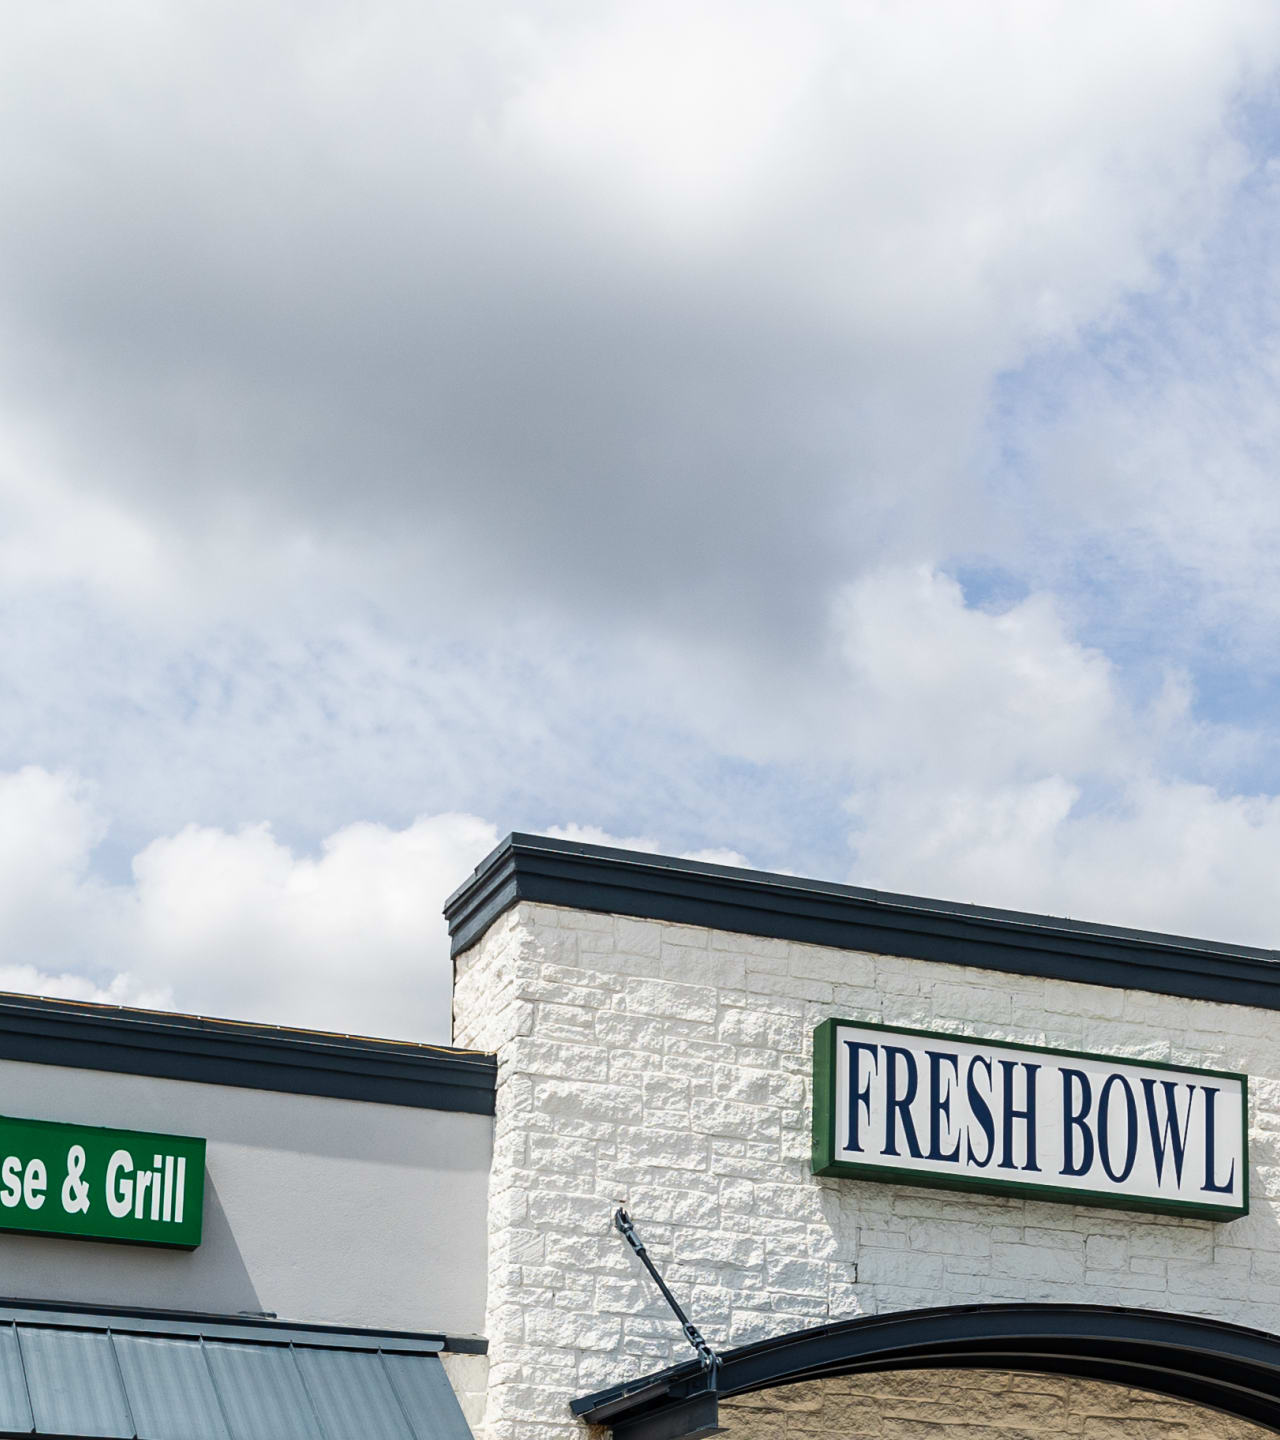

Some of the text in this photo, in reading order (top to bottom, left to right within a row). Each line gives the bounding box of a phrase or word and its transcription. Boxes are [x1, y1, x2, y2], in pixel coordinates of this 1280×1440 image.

[843, 1040, 1234, 1194] FRESH BOWL
[61, 1144, 90, 1215] &
[105, 1149, 187, 1223] Grill
